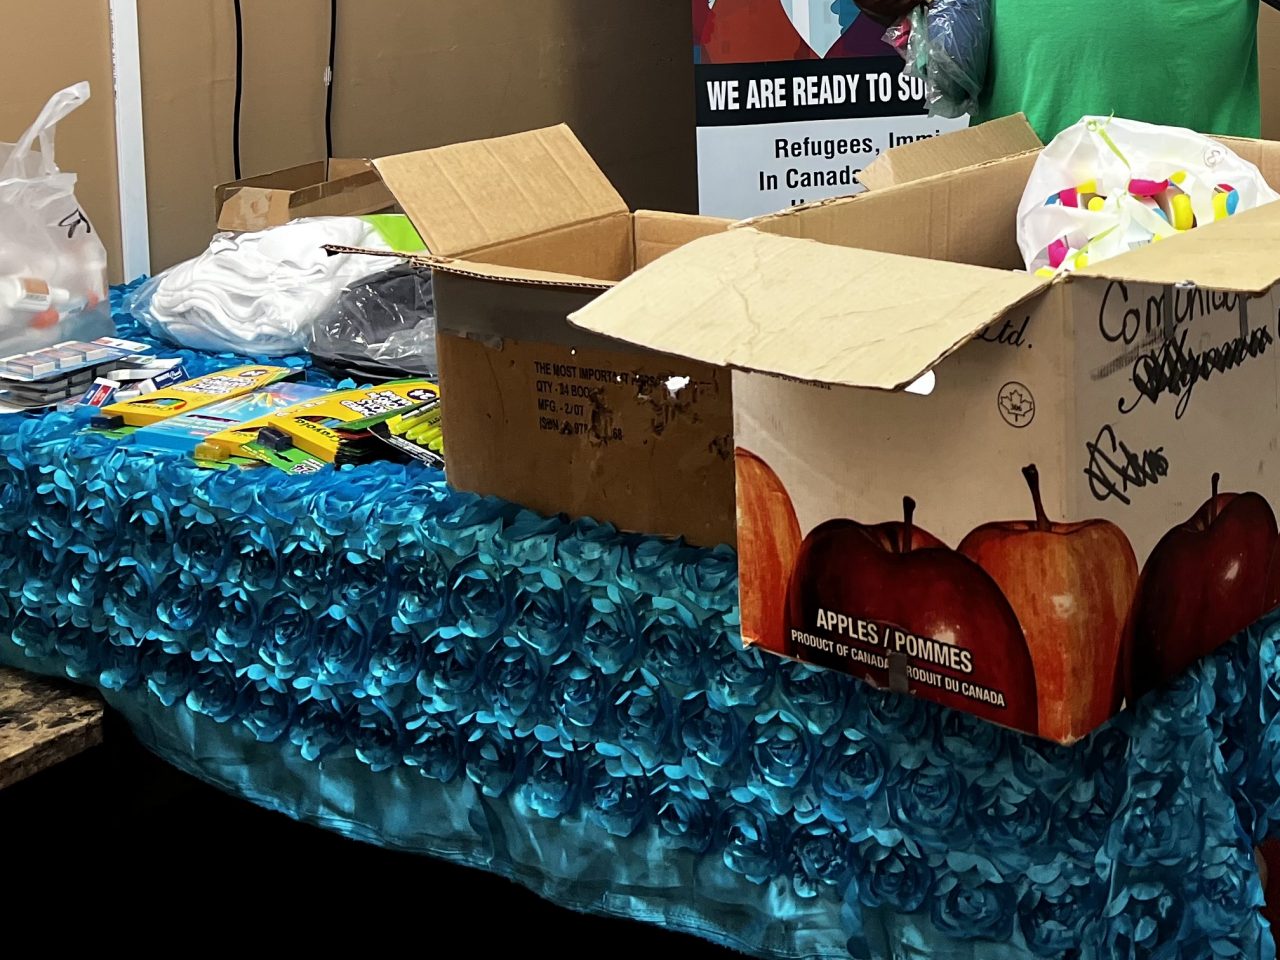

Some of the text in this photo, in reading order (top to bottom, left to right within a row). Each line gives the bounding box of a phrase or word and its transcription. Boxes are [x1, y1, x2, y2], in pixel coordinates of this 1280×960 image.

[706, 72, 928, 110] WE ARE READY TO SU
[775, 137, 880, 159] Refugees,
[759, 165, 862, 191] In Canada
[534, 361, 551, 376] THE
[553, 364, 577, 378] MOST
[816, 608, 973, 673] APPLES / POMMES
[791, 629, 1005, 707] PRODUCT OF CANADA RODUIT DU CANADA
